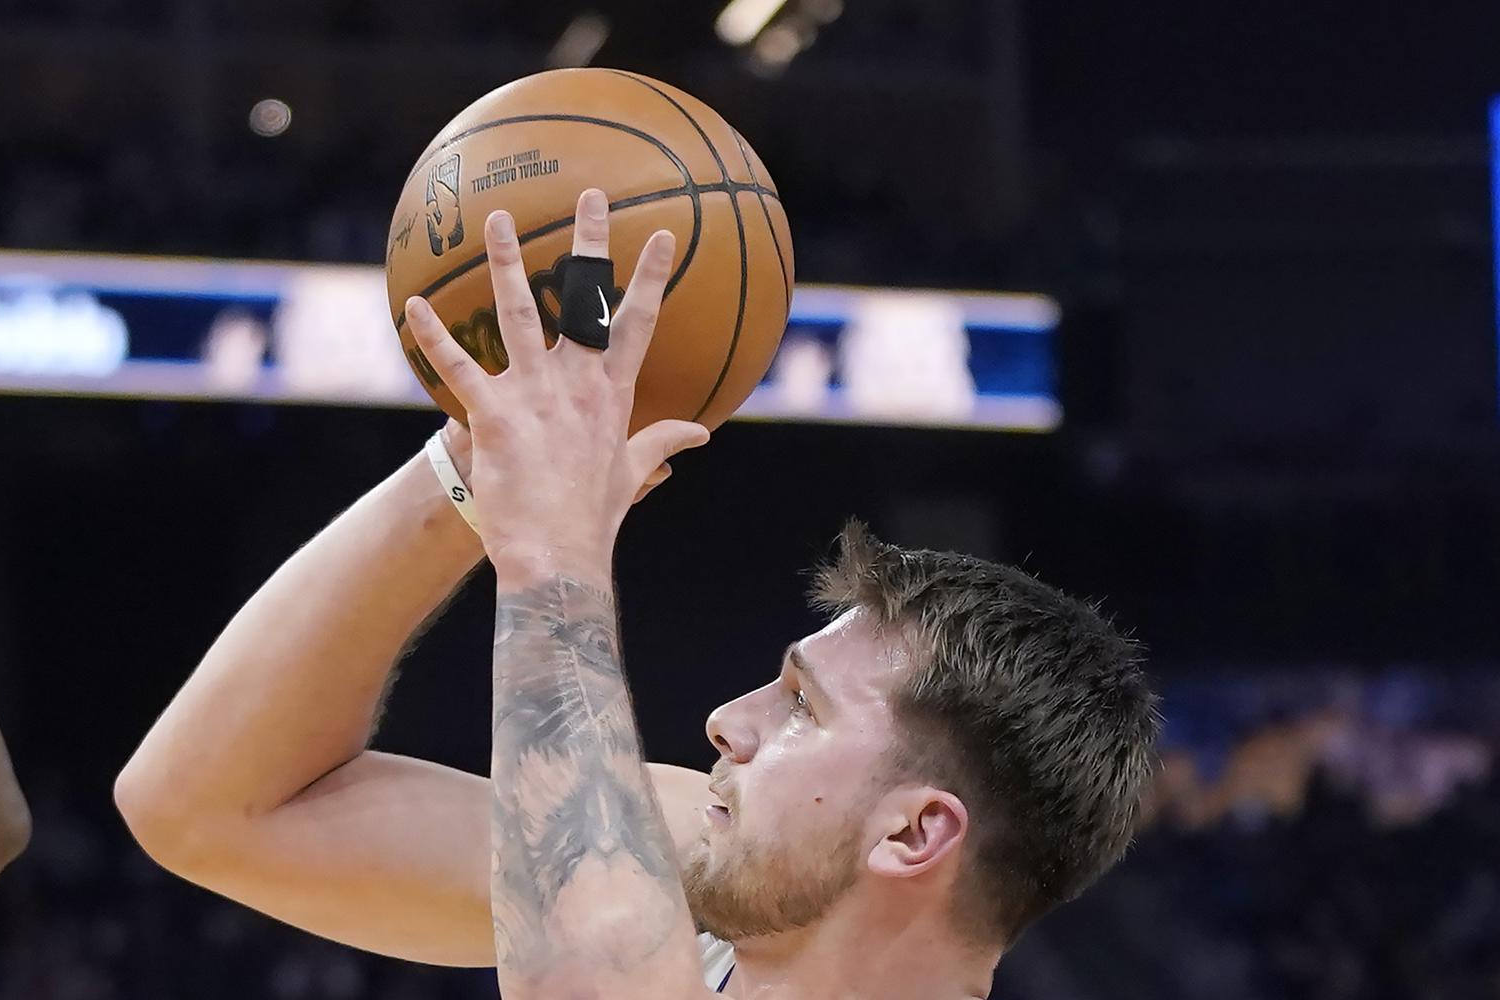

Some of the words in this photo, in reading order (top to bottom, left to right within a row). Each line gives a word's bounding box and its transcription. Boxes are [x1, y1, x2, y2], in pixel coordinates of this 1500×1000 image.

[493, 168, 517, 187] GAME
[519, 159, 559, 180] OFFICIAL
[472, 174, 492, 194] BALL
